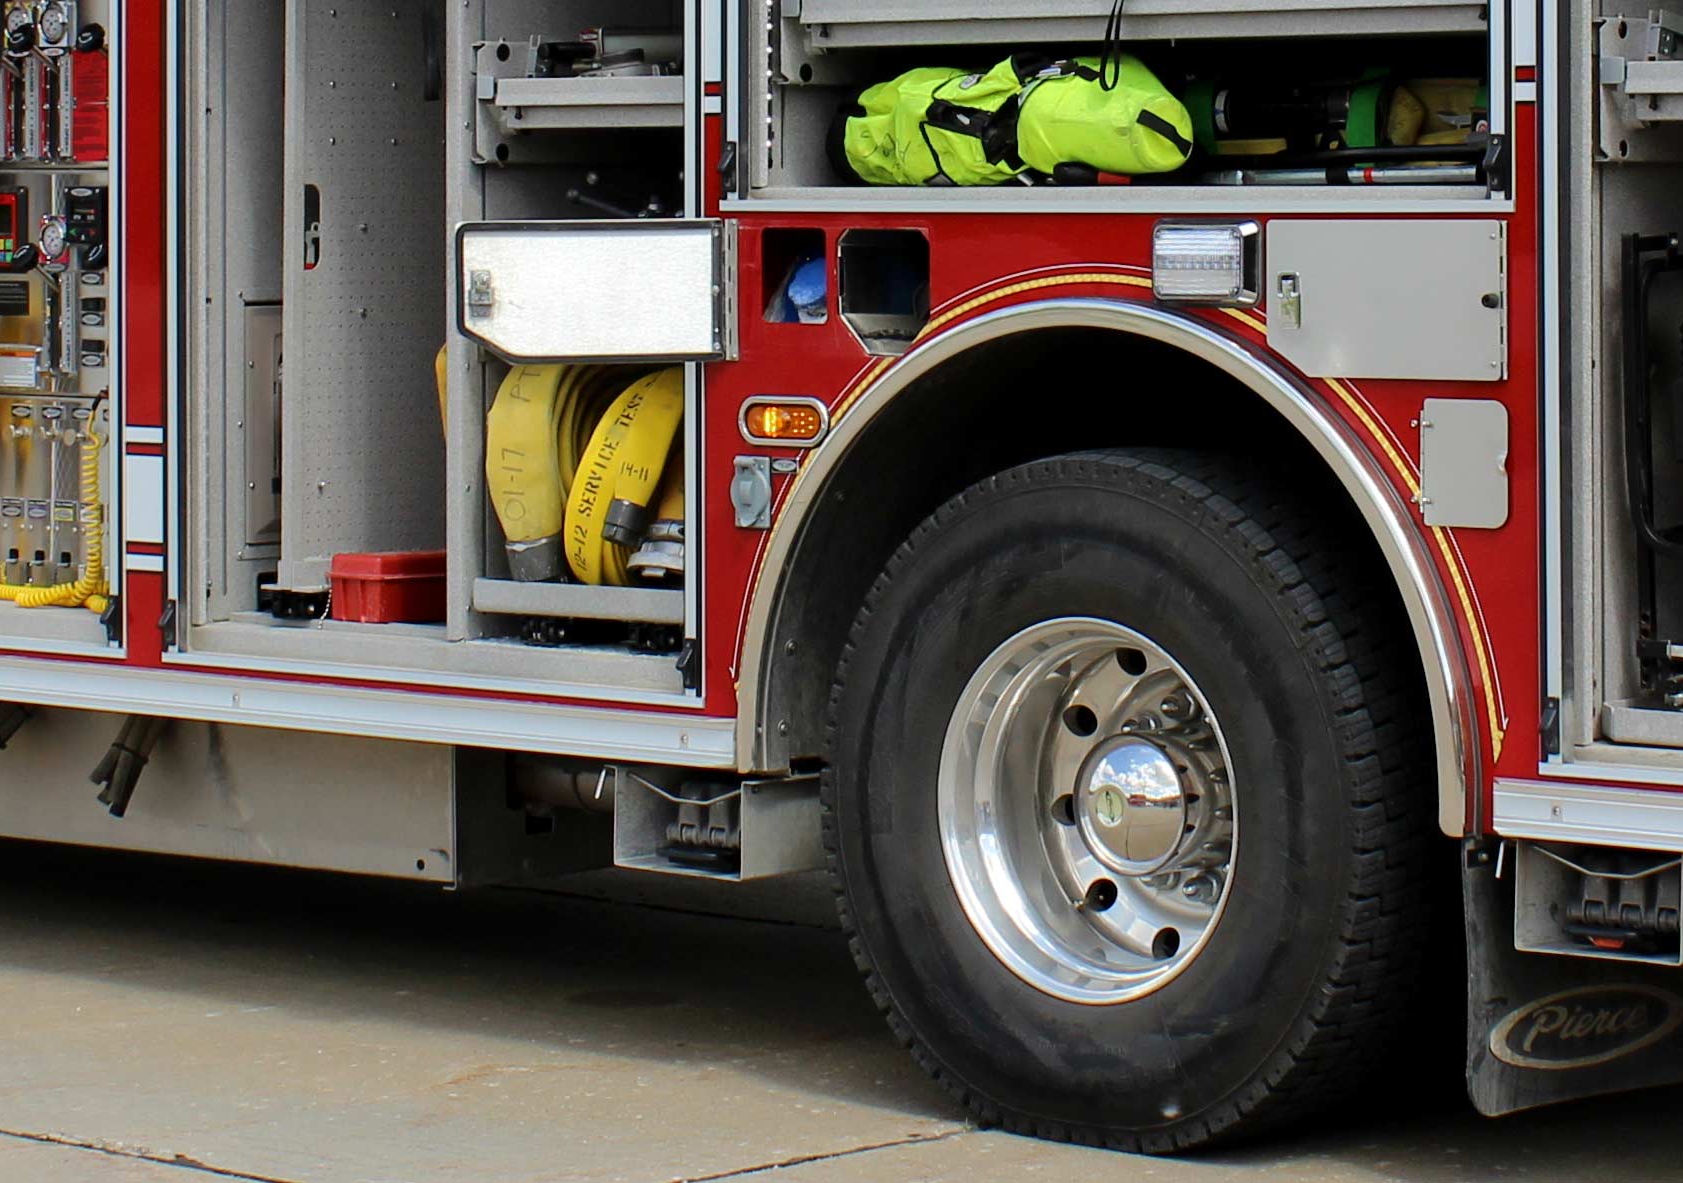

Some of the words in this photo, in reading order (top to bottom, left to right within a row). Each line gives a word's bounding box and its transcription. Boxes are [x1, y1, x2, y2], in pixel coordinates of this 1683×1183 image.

[578, 436, 620, 518] SERVICE
[615, 393, 644, 432] TEST
[1522, 1004, 1648, 1053] Pierce
